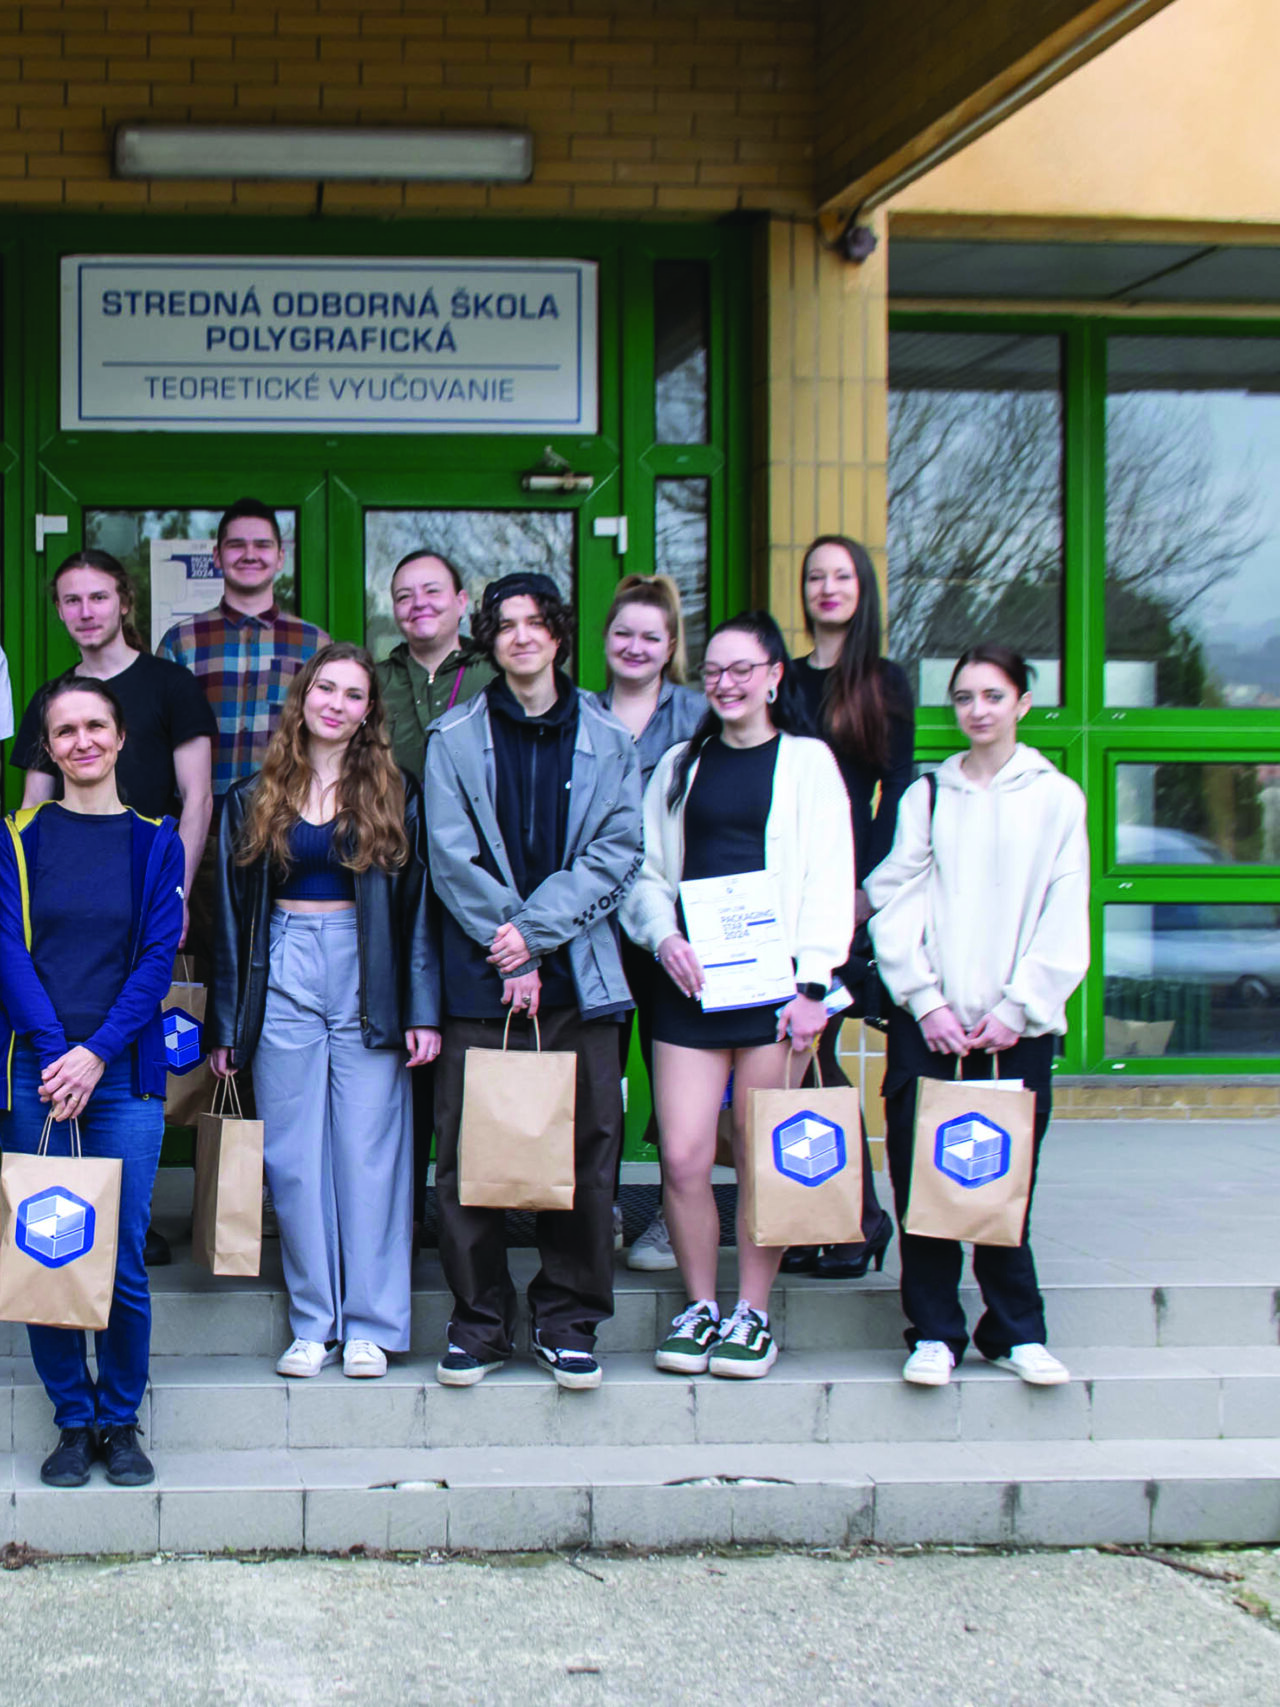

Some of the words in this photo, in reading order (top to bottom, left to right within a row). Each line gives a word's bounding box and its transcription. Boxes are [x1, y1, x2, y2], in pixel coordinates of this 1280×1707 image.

[102, 285, 261, 317] STREDNÁ
[273, 286, 439, 319] ODBORNÁ
[451, 286, 559, 320] ŠKOLA
[206, 321, 457, 353] POLYGRAFICKÁ
[144, 372, 319, 401] TEORETICKÉ
[328, 373, 516, 403] VYUČOVANIE
[191, 569, 214, 577] 2024
[623, 855, 645, 885] THE
